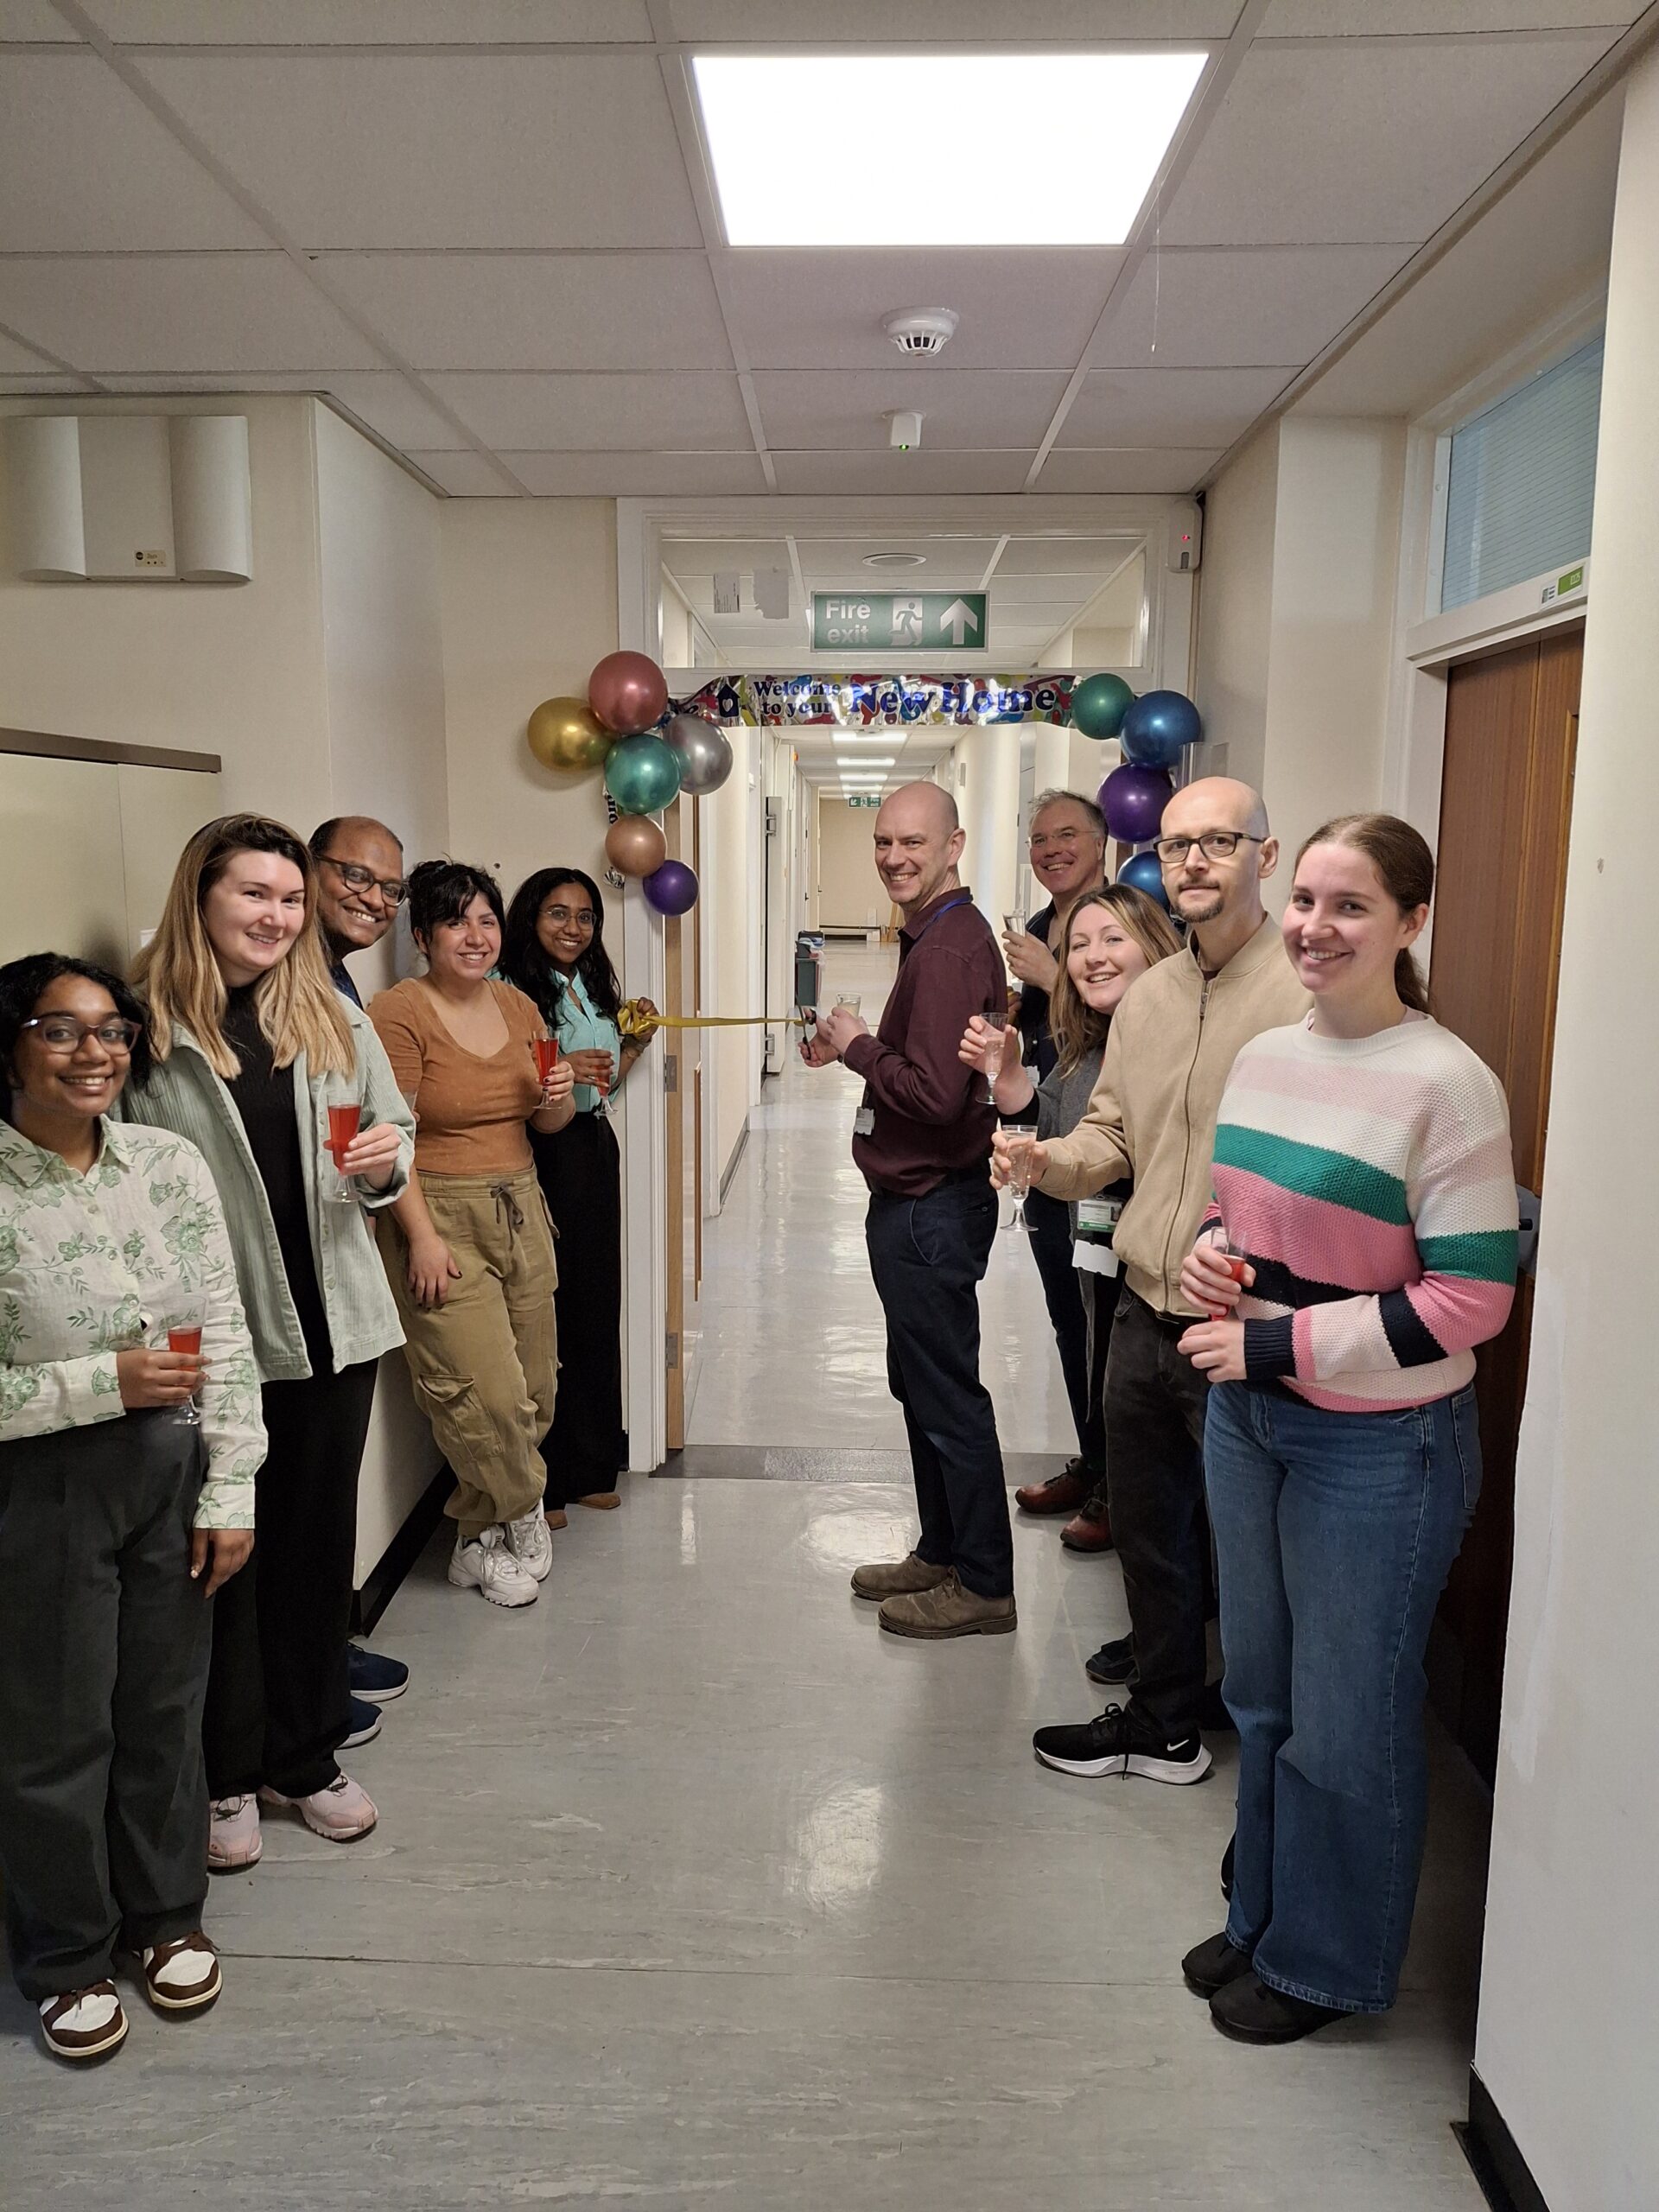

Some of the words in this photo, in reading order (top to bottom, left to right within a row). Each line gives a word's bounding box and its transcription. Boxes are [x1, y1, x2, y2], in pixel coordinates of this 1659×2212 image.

[825, 600, 871, 620] Fire
[827, 625, 869, 644] exit
[753, 681, 842, 696] Welcome
[849, 682, 936, 713] New
[940, 682, 1055, 713] Home
[762, 701, 782, 715] to
[787, 702, 832, 718] your
